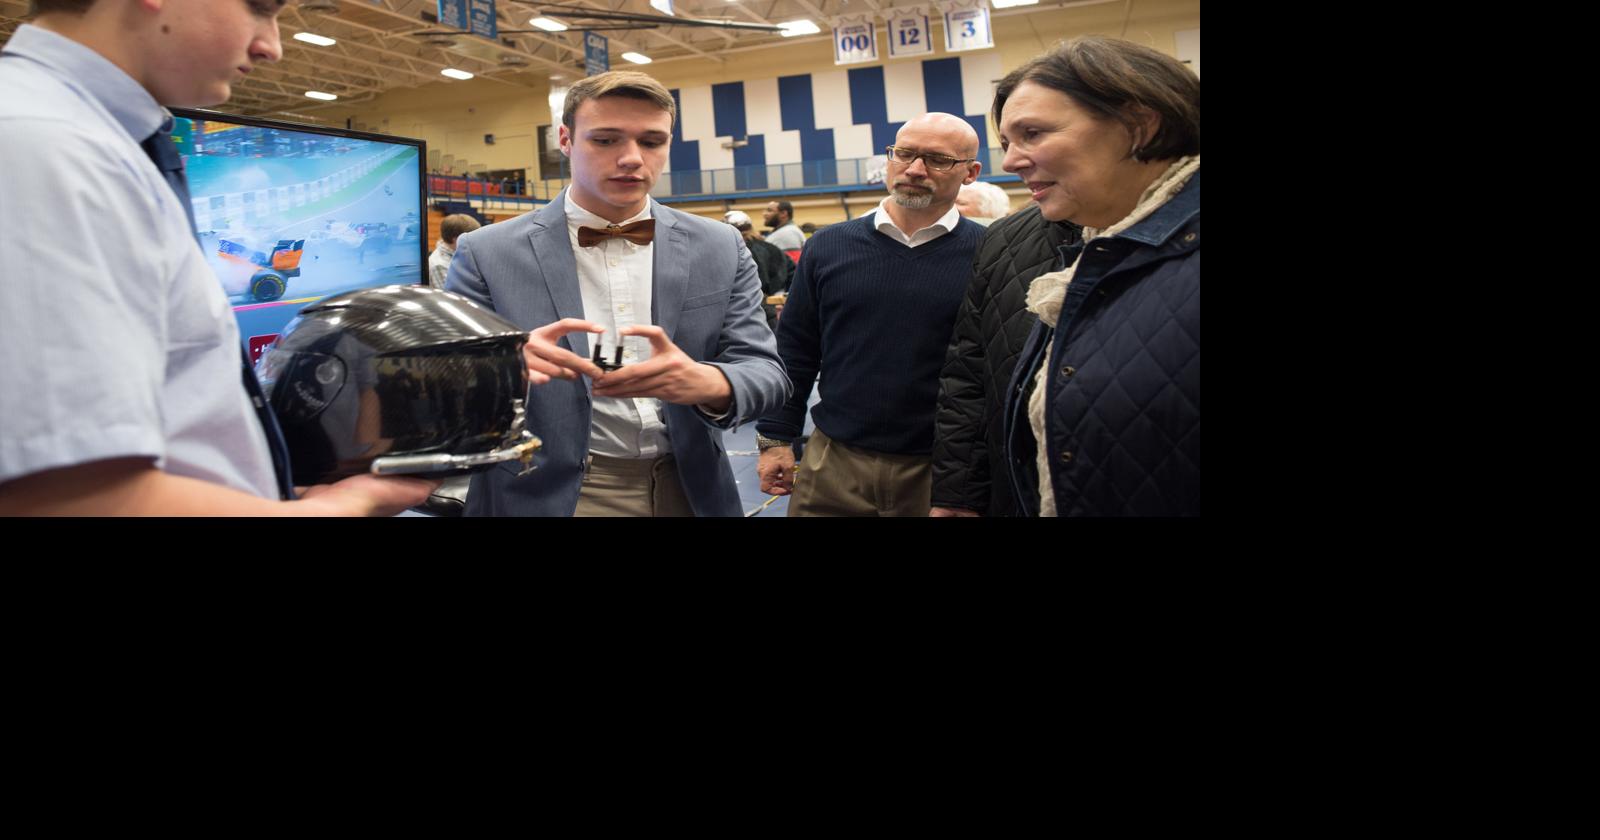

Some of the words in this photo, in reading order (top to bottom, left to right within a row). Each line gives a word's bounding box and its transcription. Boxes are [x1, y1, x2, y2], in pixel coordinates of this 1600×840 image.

[899, 28, 920, 46] 12
[961, 21, 976, 38] 3
[841, 34, 869, 52] 00
